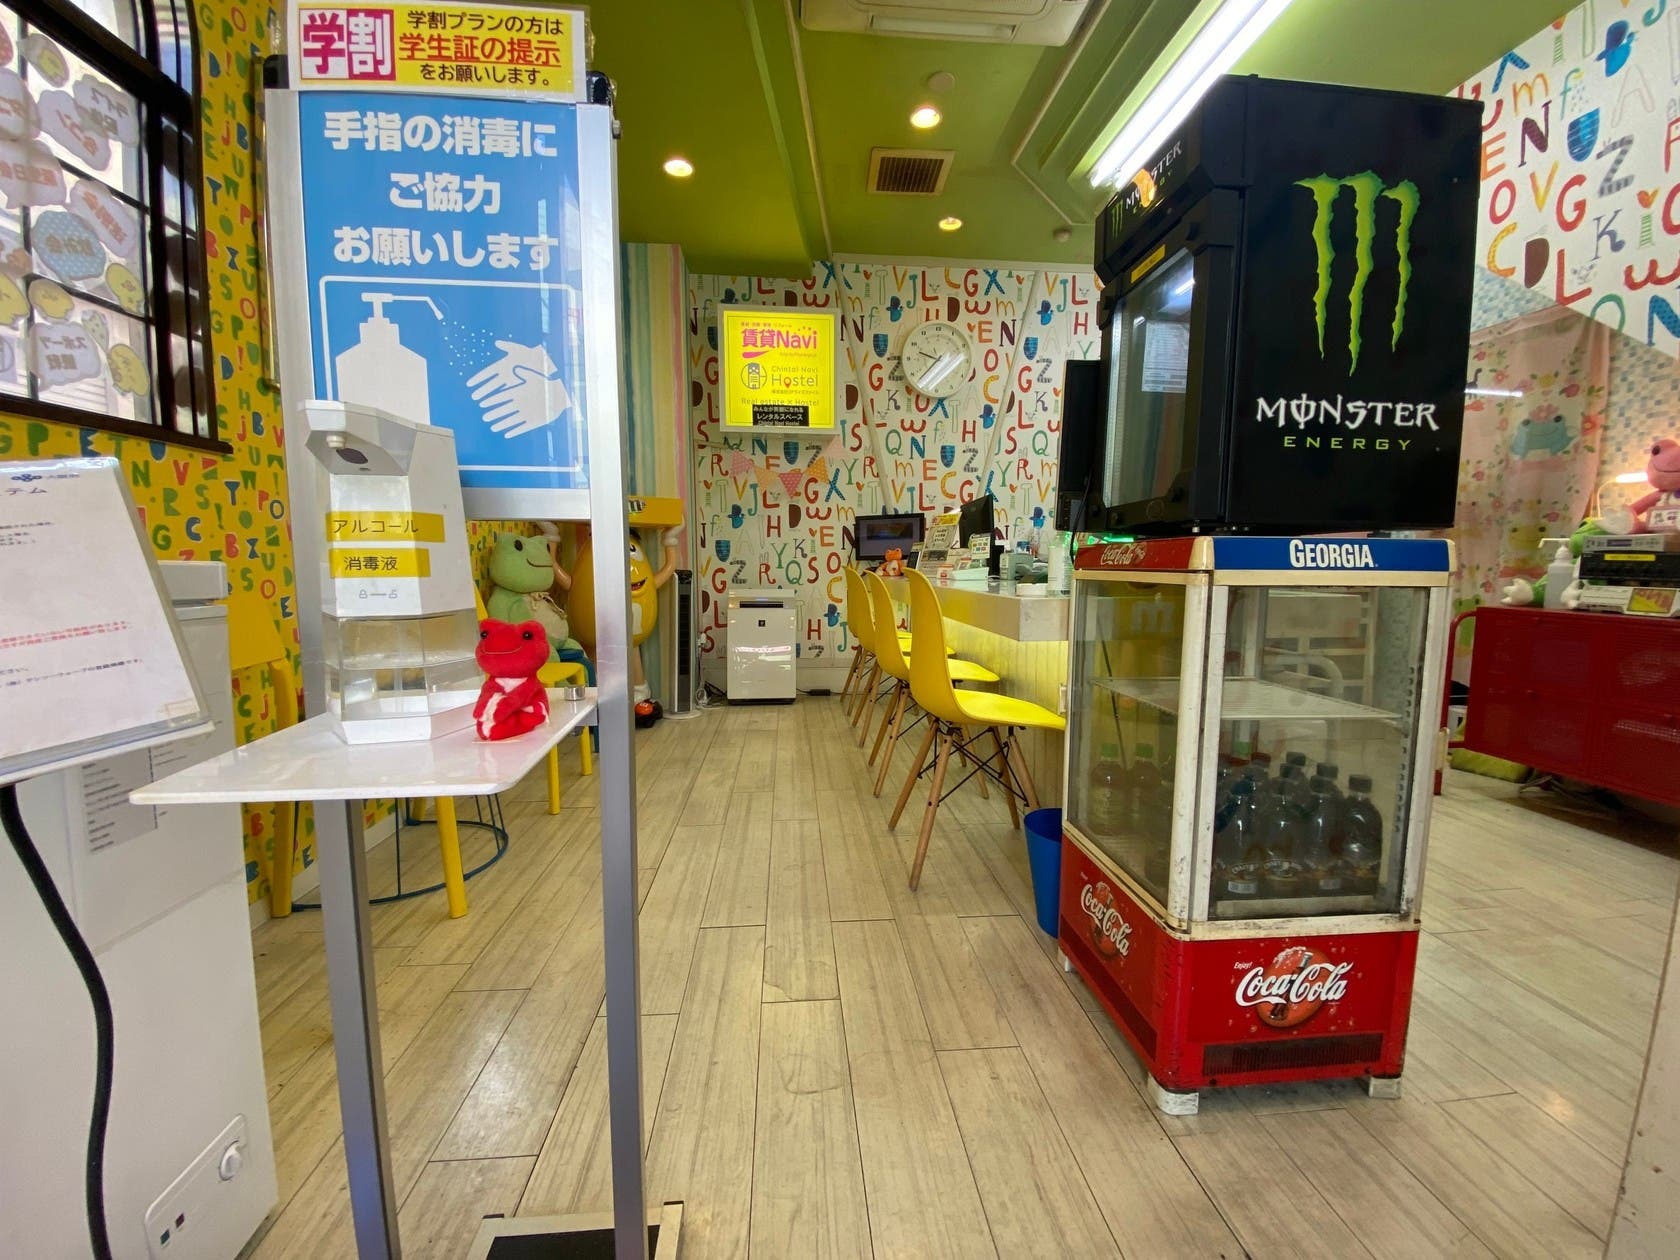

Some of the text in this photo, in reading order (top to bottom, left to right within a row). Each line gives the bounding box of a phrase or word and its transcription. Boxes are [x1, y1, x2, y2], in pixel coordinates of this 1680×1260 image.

[407, 10, 563, 35] 学割プランの方は
[303, 12, 392, 76] 学割
[399, 33, 561, 64] 学生証の提示
[420, 63, 550, 86] をお願いします。
[324, 111, 557, 158] 手指の消毒に
[389, 172, 500, 214] ご協力
[333, 226, 559, 271] お願いします
[742, 328, 817, 349] 賃貸Navi
[772, 374, 818, 388] Hostel
[1256, 393, 1439, 432] MONSTER
[1284, 436, 1411, 451] ENERGY
[333, 519, 419, 534] アルコール
[344, 556, 398, 571] 消毒液
[1289, 539, 1374, 568] GEORGIA
[1080, 883, 1132, 957] Coca-Cola
[1235, 961, 1353, 1007] Coca-Cola
